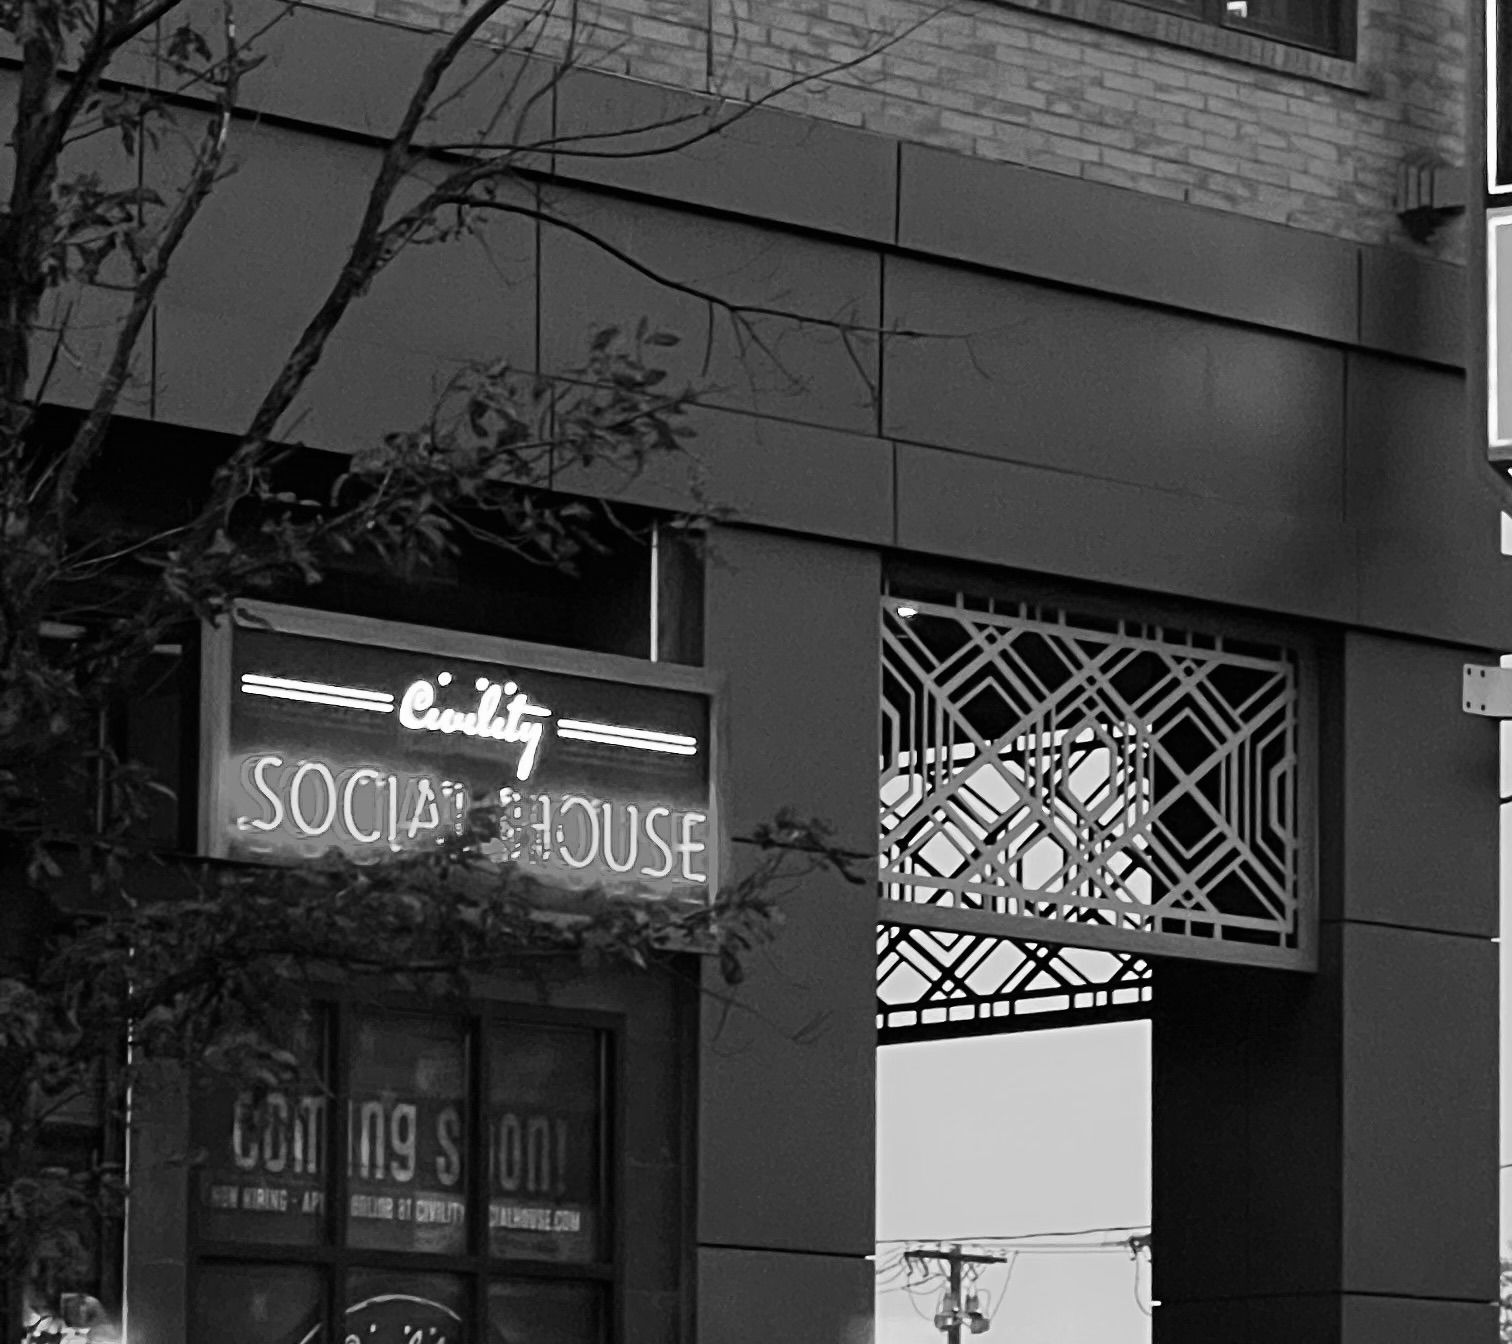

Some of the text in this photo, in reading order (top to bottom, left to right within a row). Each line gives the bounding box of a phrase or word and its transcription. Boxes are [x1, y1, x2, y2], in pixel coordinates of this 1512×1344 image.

[399, 670, 552, 781] Civility
[508, 790, 707, 882] HOUSE
[436, 1106, 568, 1196] son!
